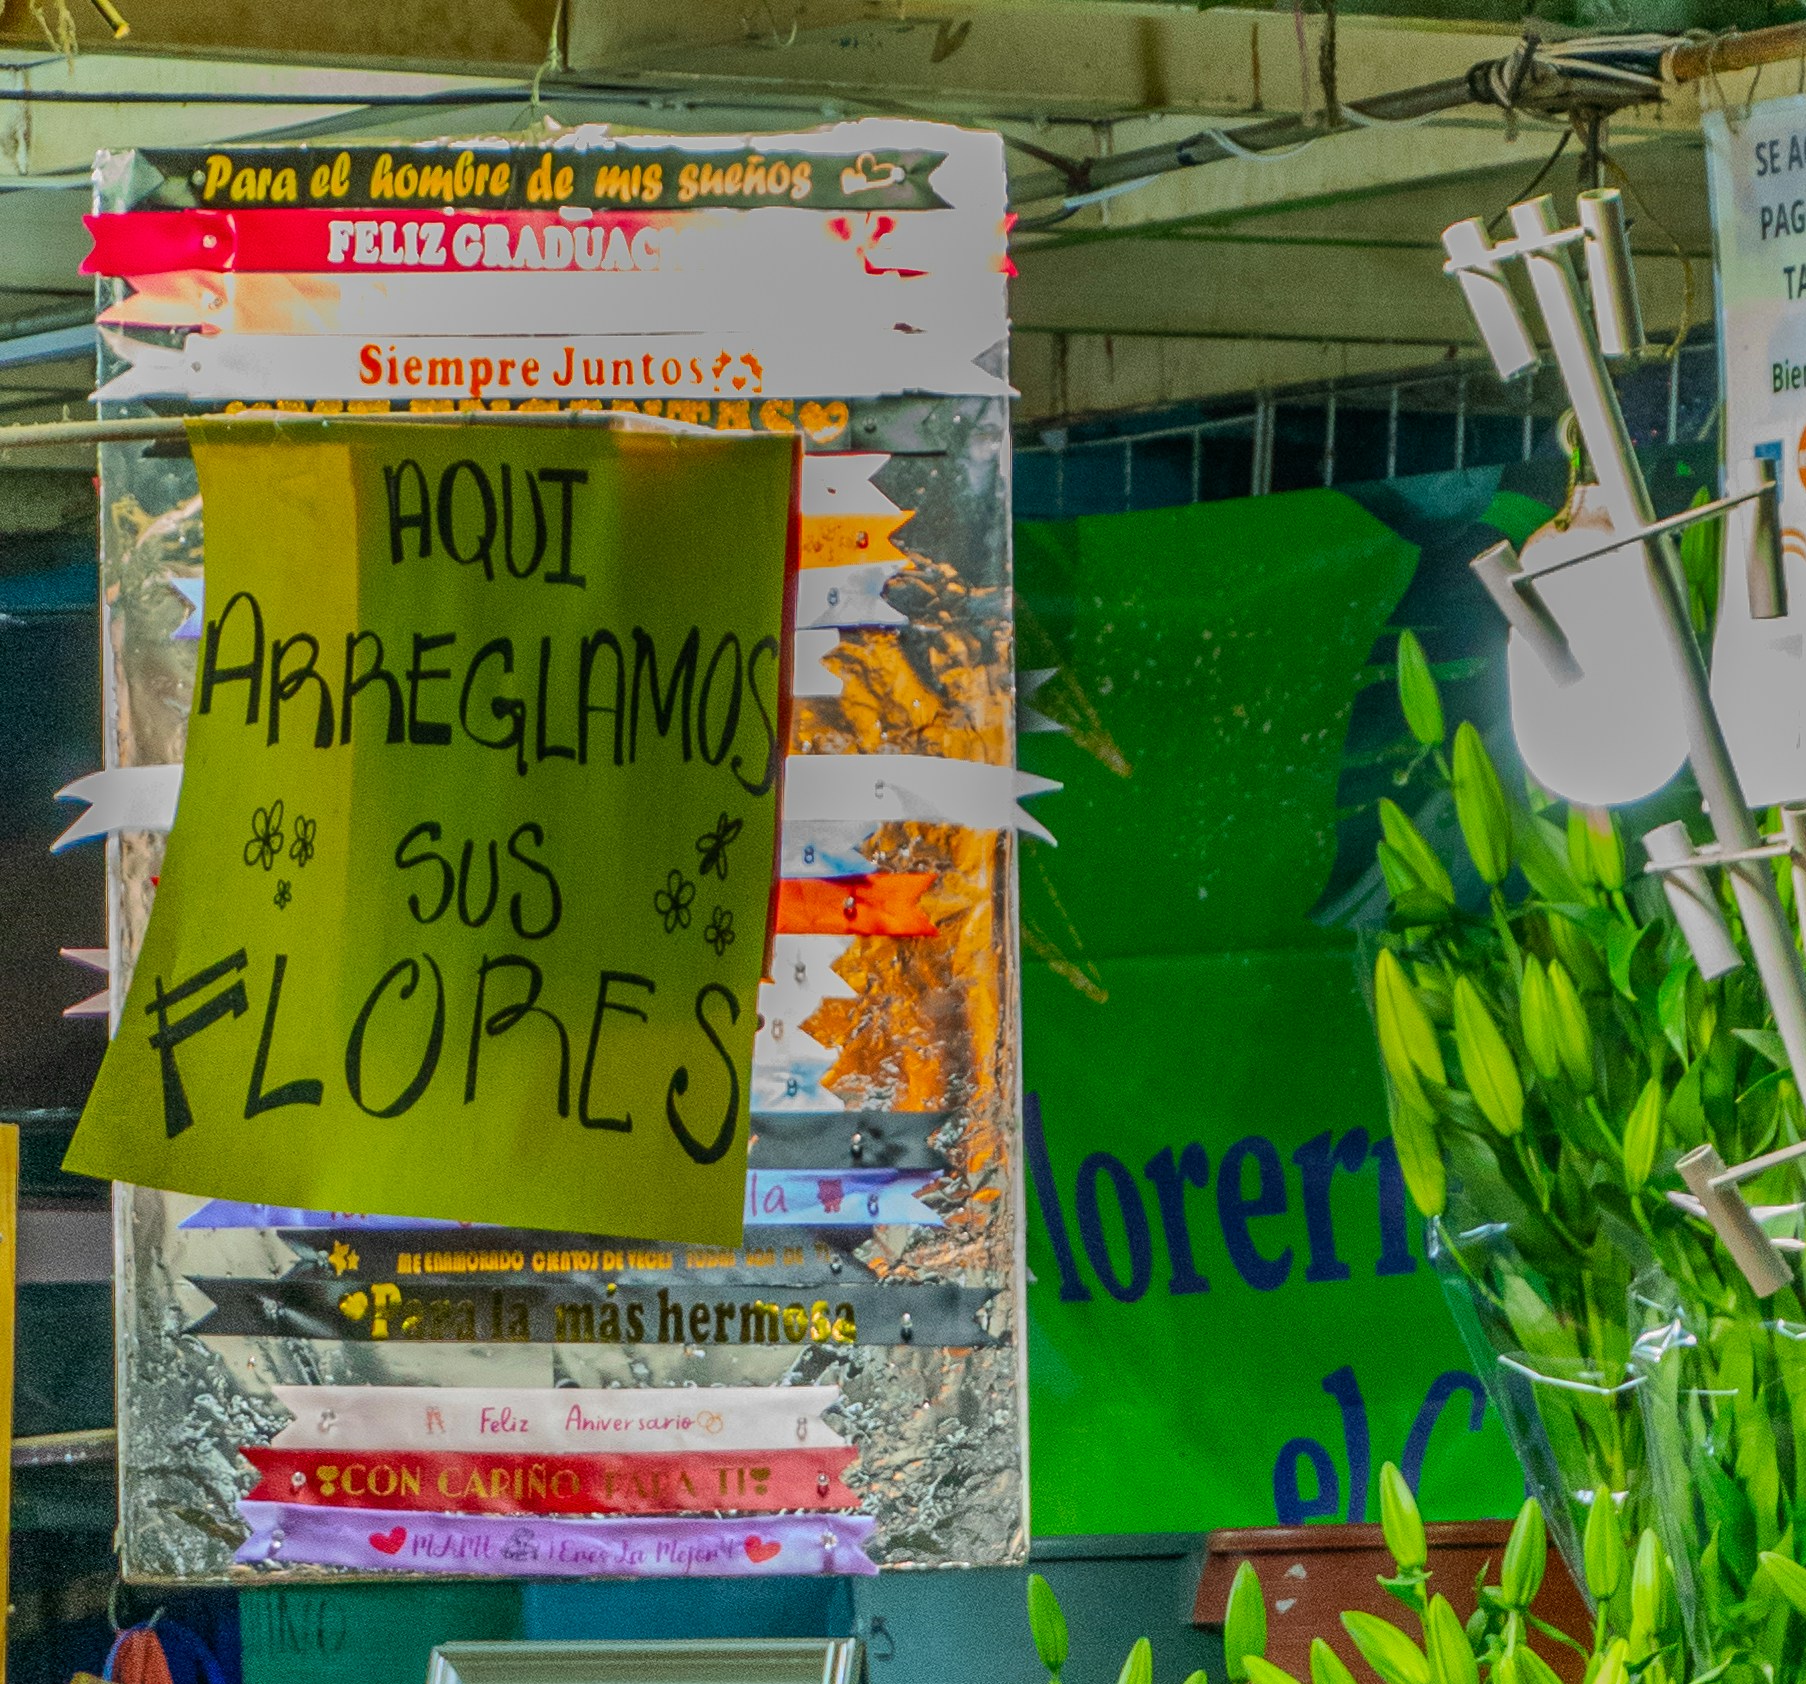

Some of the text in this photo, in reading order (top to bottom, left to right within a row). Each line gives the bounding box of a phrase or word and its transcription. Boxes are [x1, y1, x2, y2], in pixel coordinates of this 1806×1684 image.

[203, 151, 813, 202] Para el hombre de mis sueños
[1754, 140, 1780, 177] SE
[327, 220, 447, 265] FELIZ
[359, 344, 704, 398] Siempre Juntos
[382, 457, 590, 589] AQUI
[200, 591, 780, 796] ARREGLAMOS
[394, 820, 565, 940] SUS
[144, 945, 742, 1166] FLORES
[371, 1283, 857, 1343] Para la más hermosa
[480, 1404, 696, 1434] Feliz Aniversario
[341, 1463, 421, 1496] CON
[437, 1463, 581, 1499] CARIÑO
